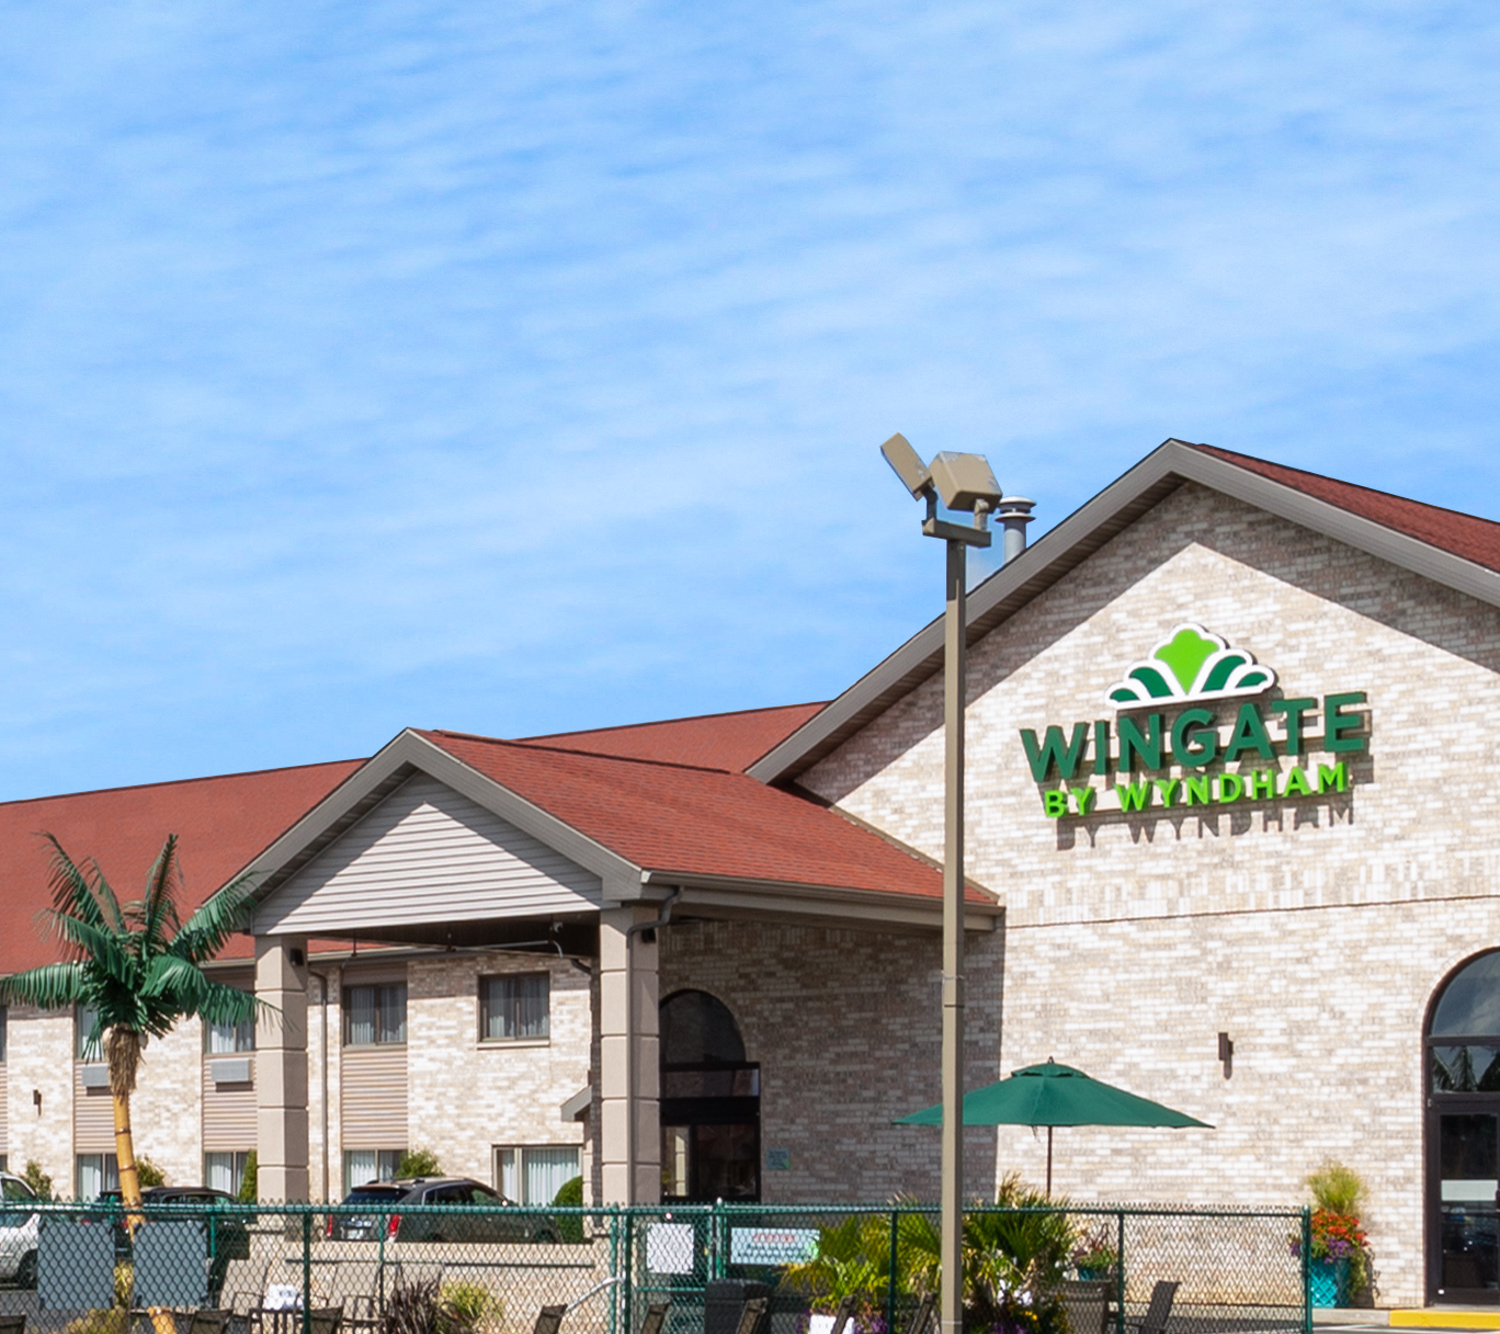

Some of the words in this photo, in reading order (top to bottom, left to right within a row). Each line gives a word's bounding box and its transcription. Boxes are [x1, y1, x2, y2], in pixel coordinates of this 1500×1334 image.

[1019, 691, 1368, 782] WINGATE
[1043, 786, 1096, 818] BY
[1115, 761, 1349, 813] WYNDHAM
